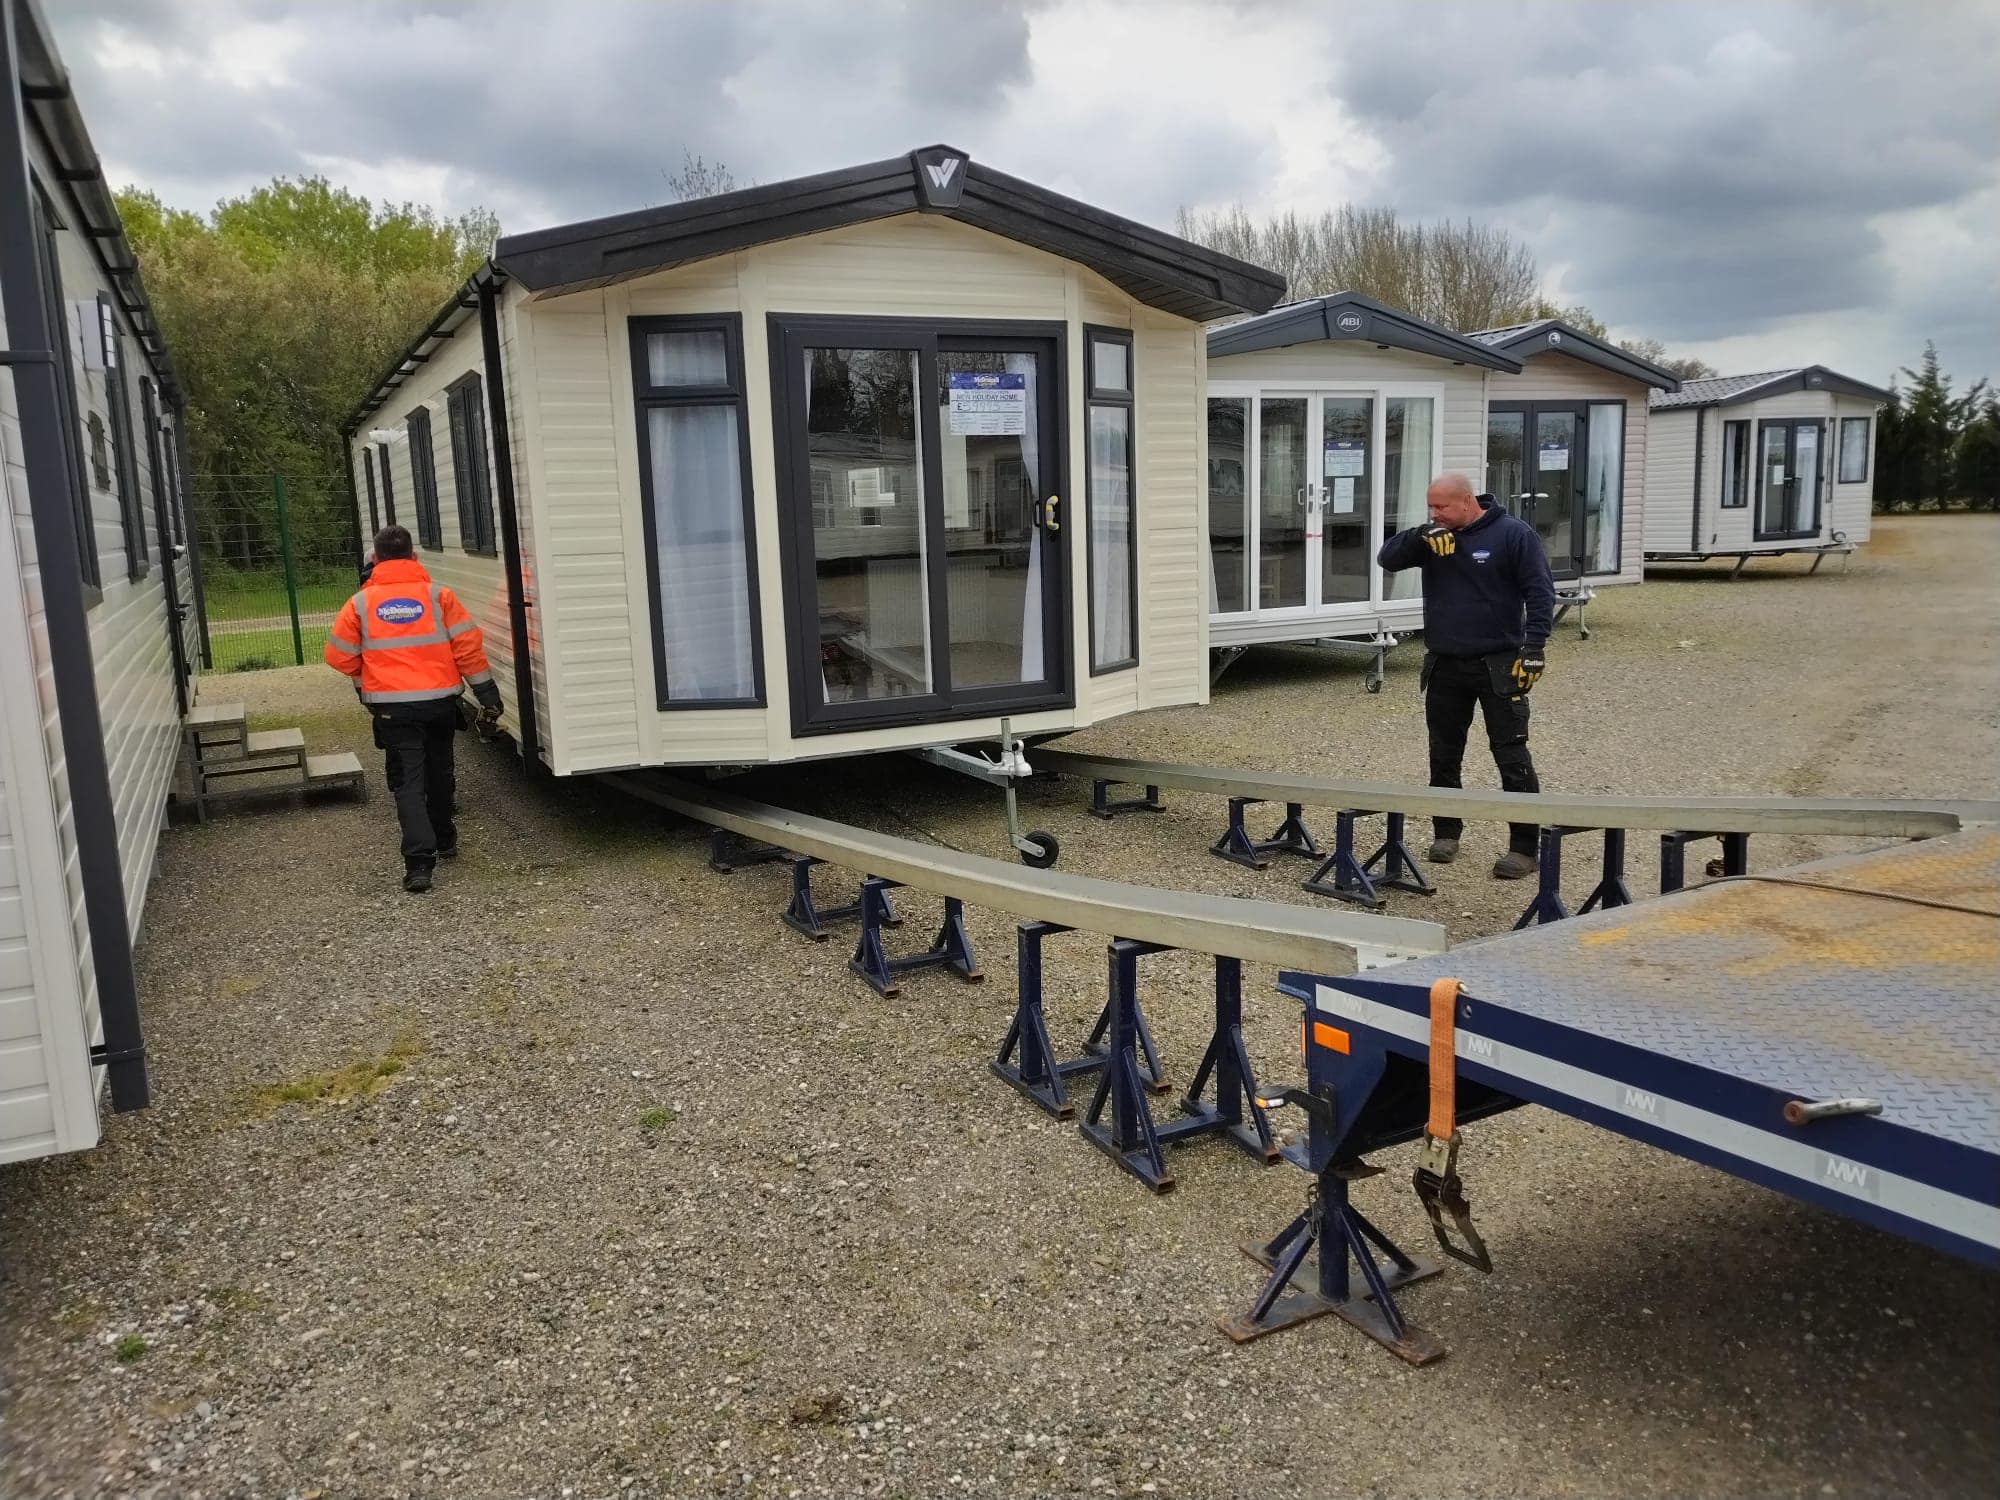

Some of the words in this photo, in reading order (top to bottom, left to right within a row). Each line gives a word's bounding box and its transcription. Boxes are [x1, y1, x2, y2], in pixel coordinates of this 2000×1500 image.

[1341, 317, 1360, 326] ABI
[1468, 1036, 1493, 1057] MW
[1625, 1089, 1656, 1113] MW
[1827, 1158, 1866, 1187] MW
